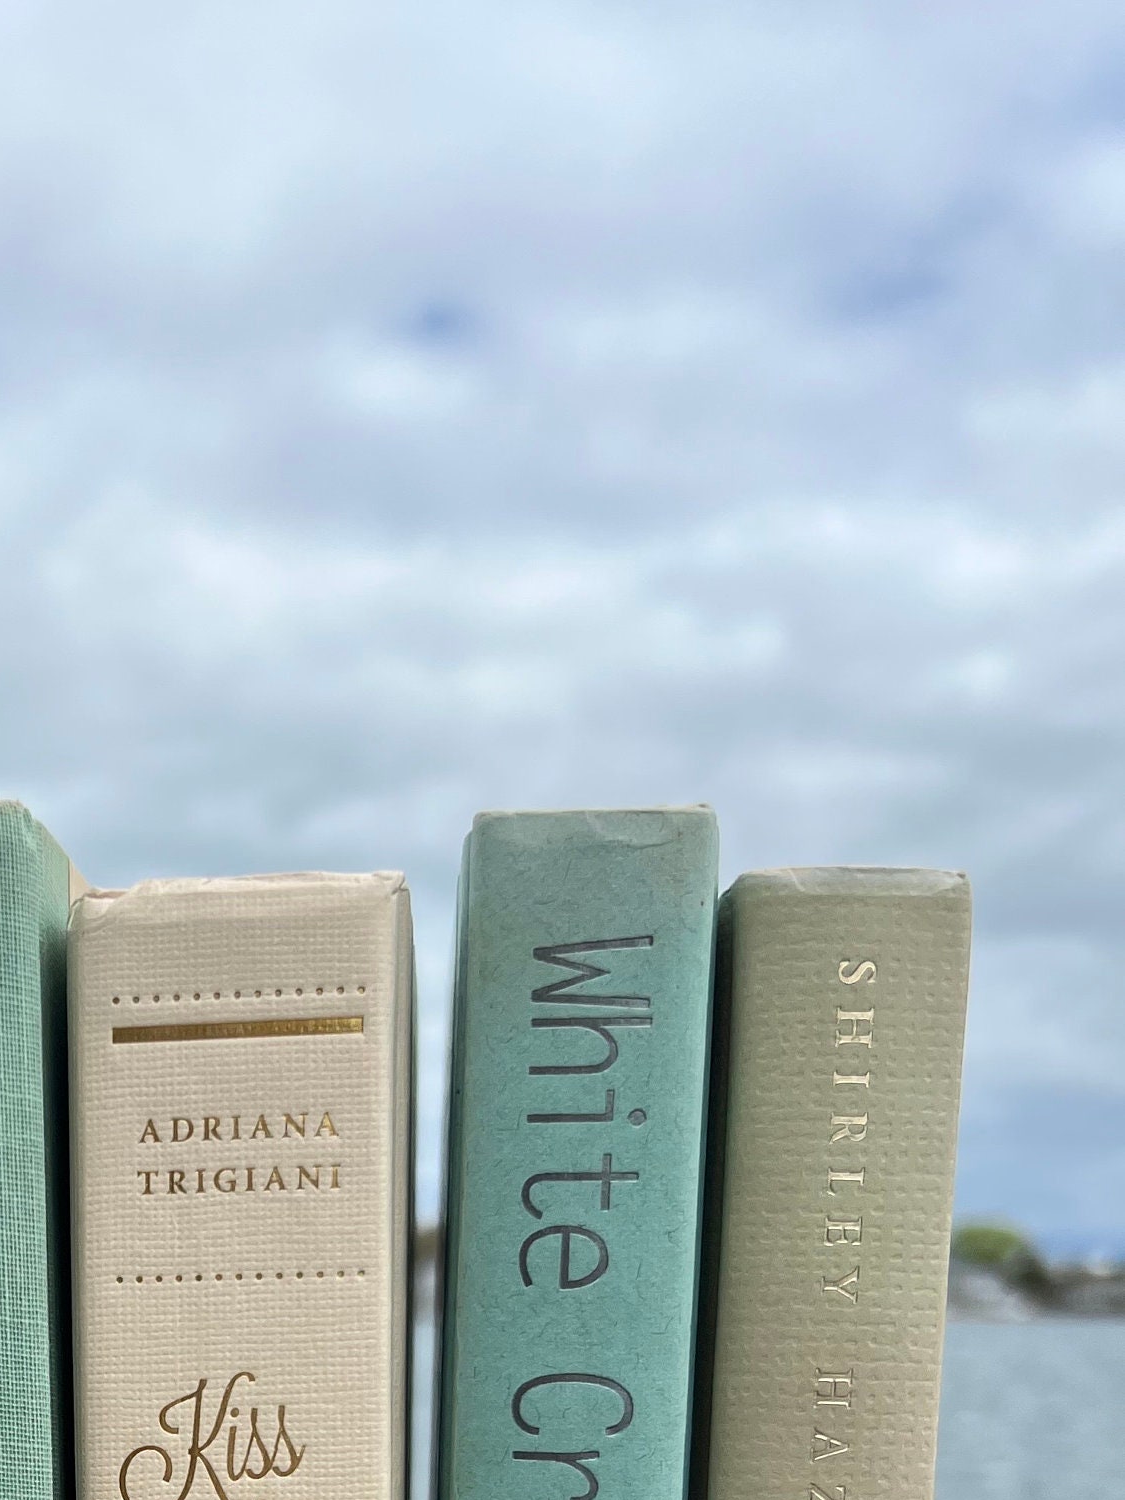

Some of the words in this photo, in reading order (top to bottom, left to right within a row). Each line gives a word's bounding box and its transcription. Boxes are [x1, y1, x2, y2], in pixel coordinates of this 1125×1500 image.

[136, 1164, 342, 1195] TRIGIANI
[137, 1111, 340, 1144] ADRIANA
[518, 936, 654, 1290] White
[820, 960, 877, 1304] SHIRLEY
